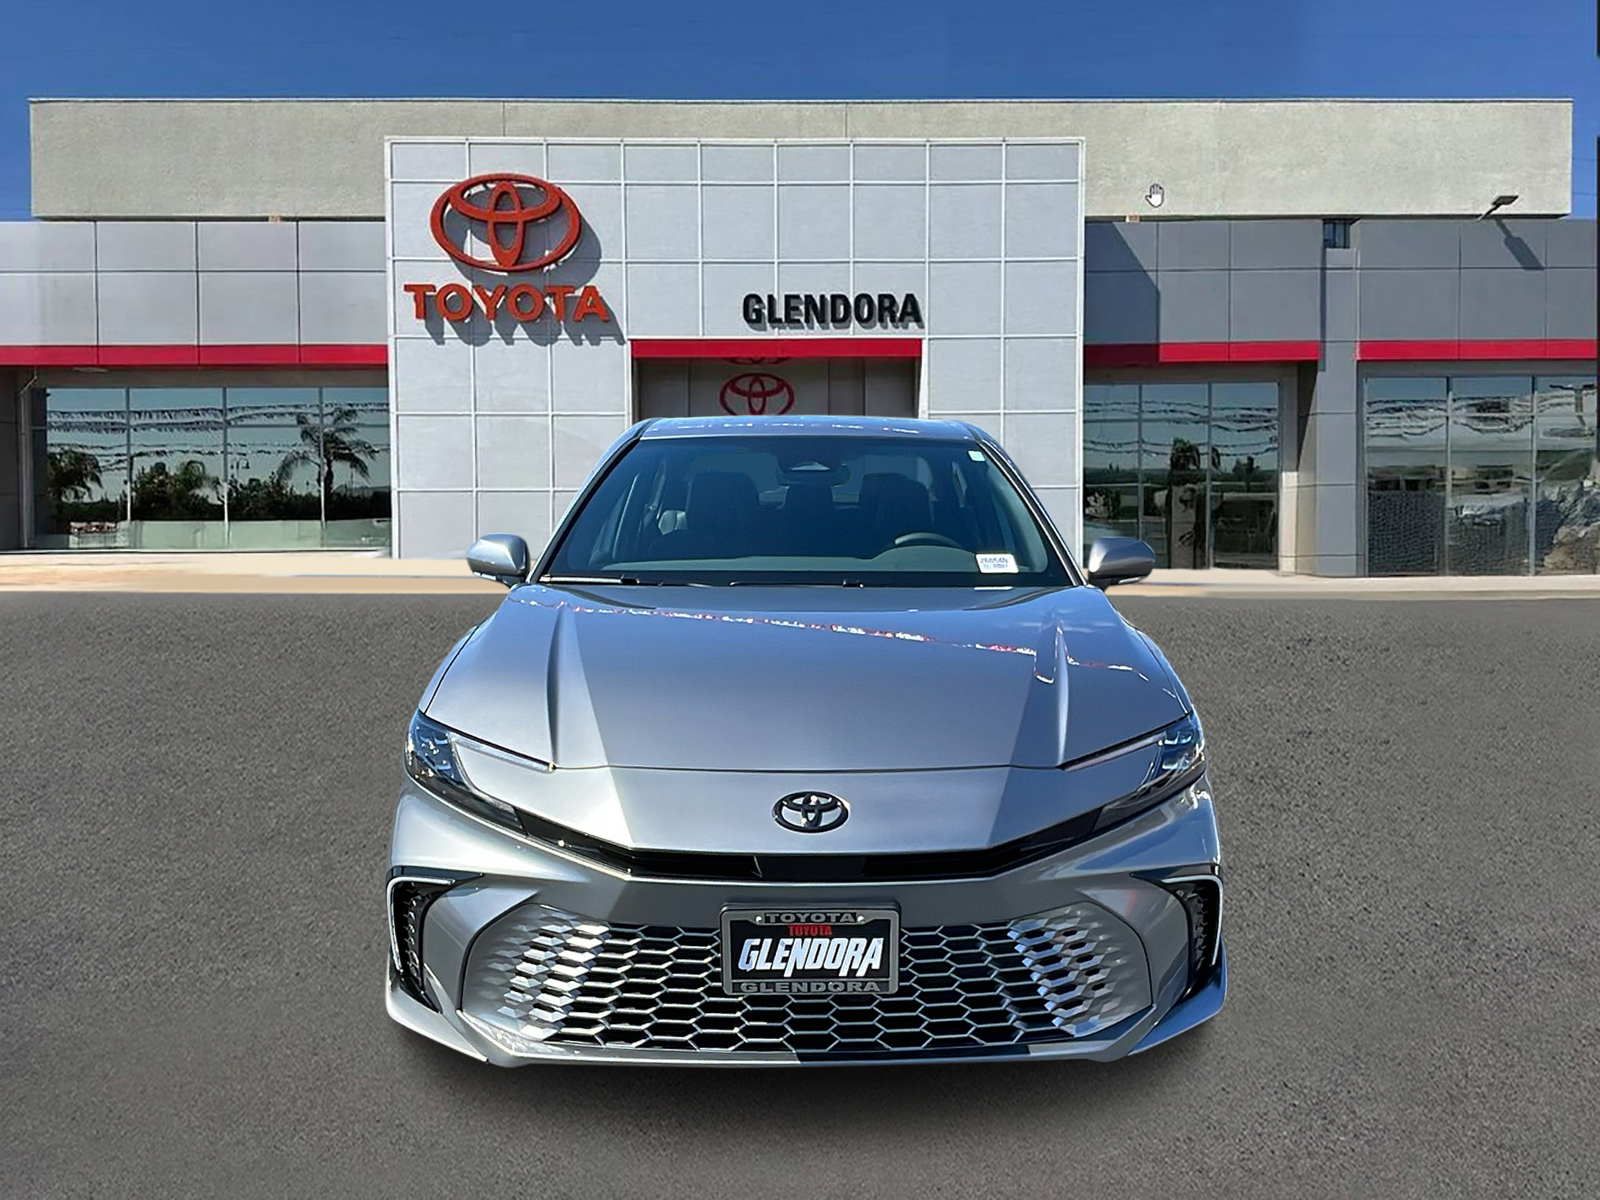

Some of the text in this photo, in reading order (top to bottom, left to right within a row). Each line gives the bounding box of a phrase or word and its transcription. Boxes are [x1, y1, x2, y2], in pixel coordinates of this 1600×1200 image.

[403, 283, 610, 322] TOYOTA
[742, 292, 922, 326] GLENDORA
[765, 913, 855, 923] TOYOTA
[788, 925, 833, 936] TOYOTA
[738, 938, 884, 977] GLENDORA
[740, 981, 881, 993] GLENDORA
